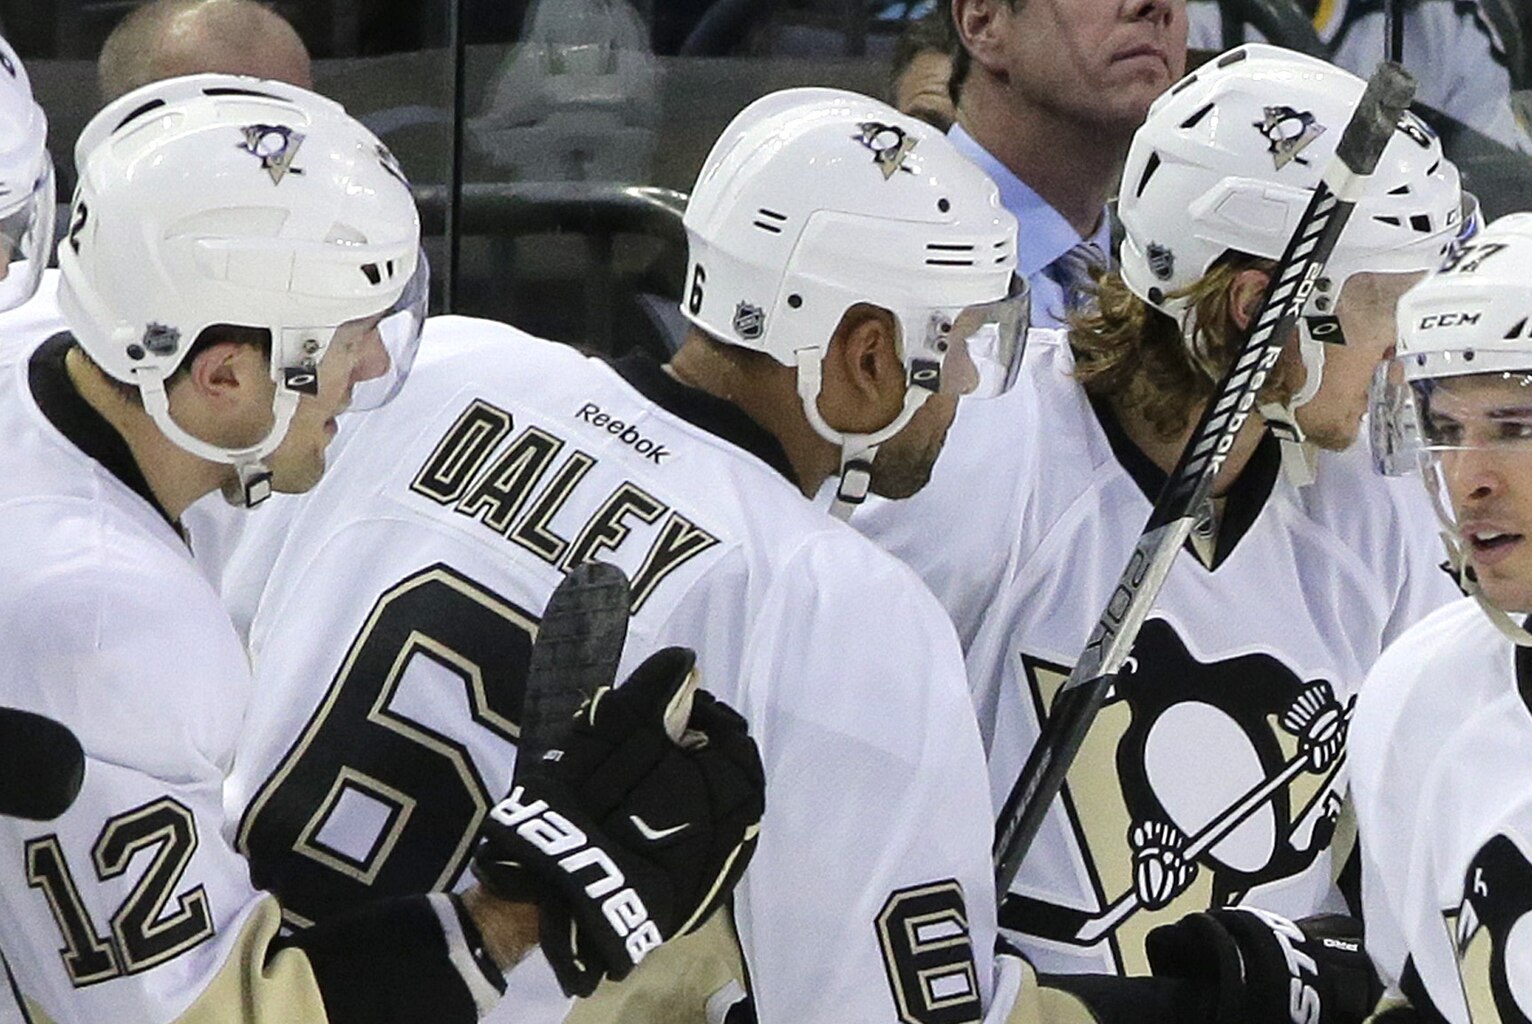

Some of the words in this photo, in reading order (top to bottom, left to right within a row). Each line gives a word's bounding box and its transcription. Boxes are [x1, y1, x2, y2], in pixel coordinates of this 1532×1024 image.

[689, 262, 706, 316] 6
[1419, 312, 1482, 331] CCM
[574, 402, 672, 465] Reebok
[1205, 346, 1284, 476] Reebok
[409, 397, 722, 617] DALEY
[24, 795, 215, 988] 12
[490, 785, 664, 965] BAUER
